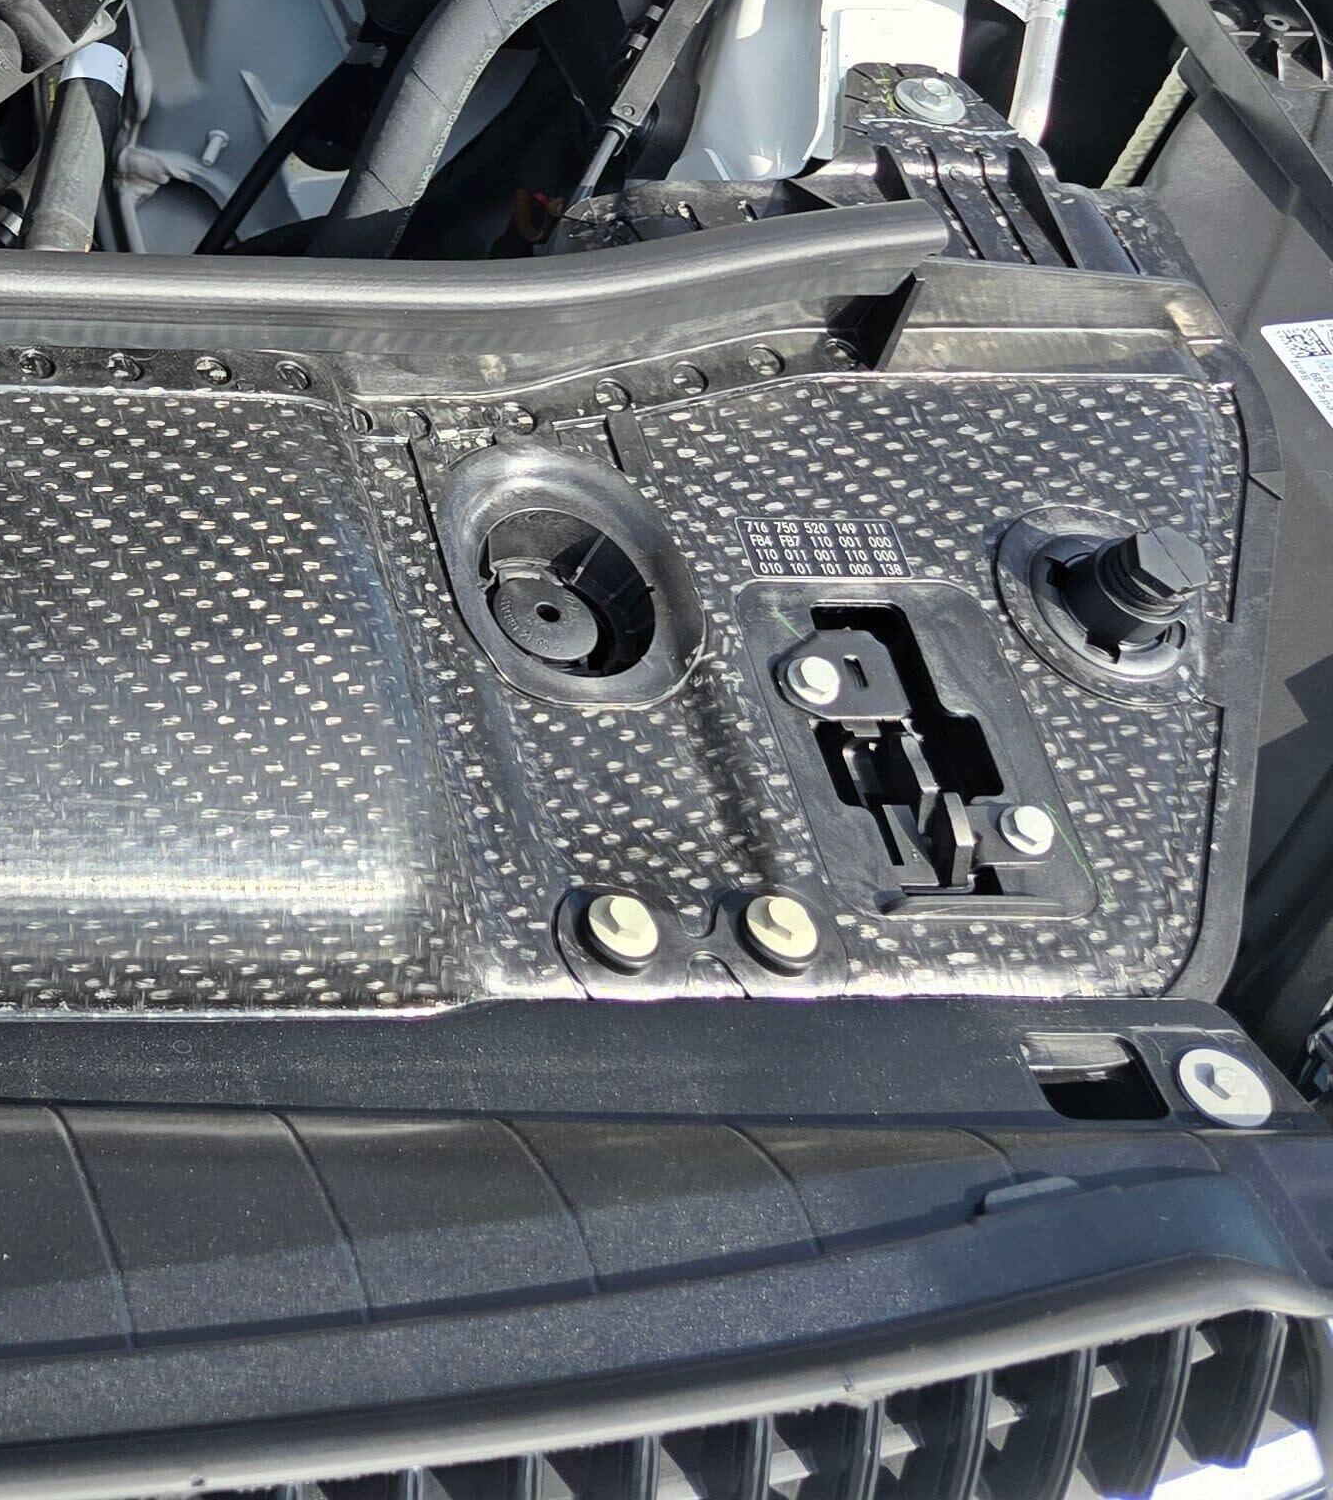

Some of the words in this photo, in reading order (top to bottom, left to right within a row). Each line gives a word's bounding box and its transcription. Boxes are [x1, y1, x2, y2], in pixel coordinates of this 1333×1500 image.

[744, 522, 768, 534] 716
[774, 522, 798, 534] 750
[804, 522, 827, 534] 520
[835, 523, 856, 534] 149
[864, 523, 886, 534] 111
[750, 535, 773, 547] FB4
[780, 535, 801, 547] FB7
[810, 536, 832, 548] 110
[839, 536, 862, 548] 001
[868, 537, 892, 548] 000
[755, 549, 778, 561] 110
[785, 549, 807, 561] 011
[814, 549, 837, 561] 001
[844, 550, 868, 561] 110
[874, 550, 898, 562] 000
[760, 563, 784, 574] 010
[790, 563, 812, 575] 101
[820, 563, 842, 575] 101
[849, 563, 873, 575] 000
[880, 563, 903, 576] 138
